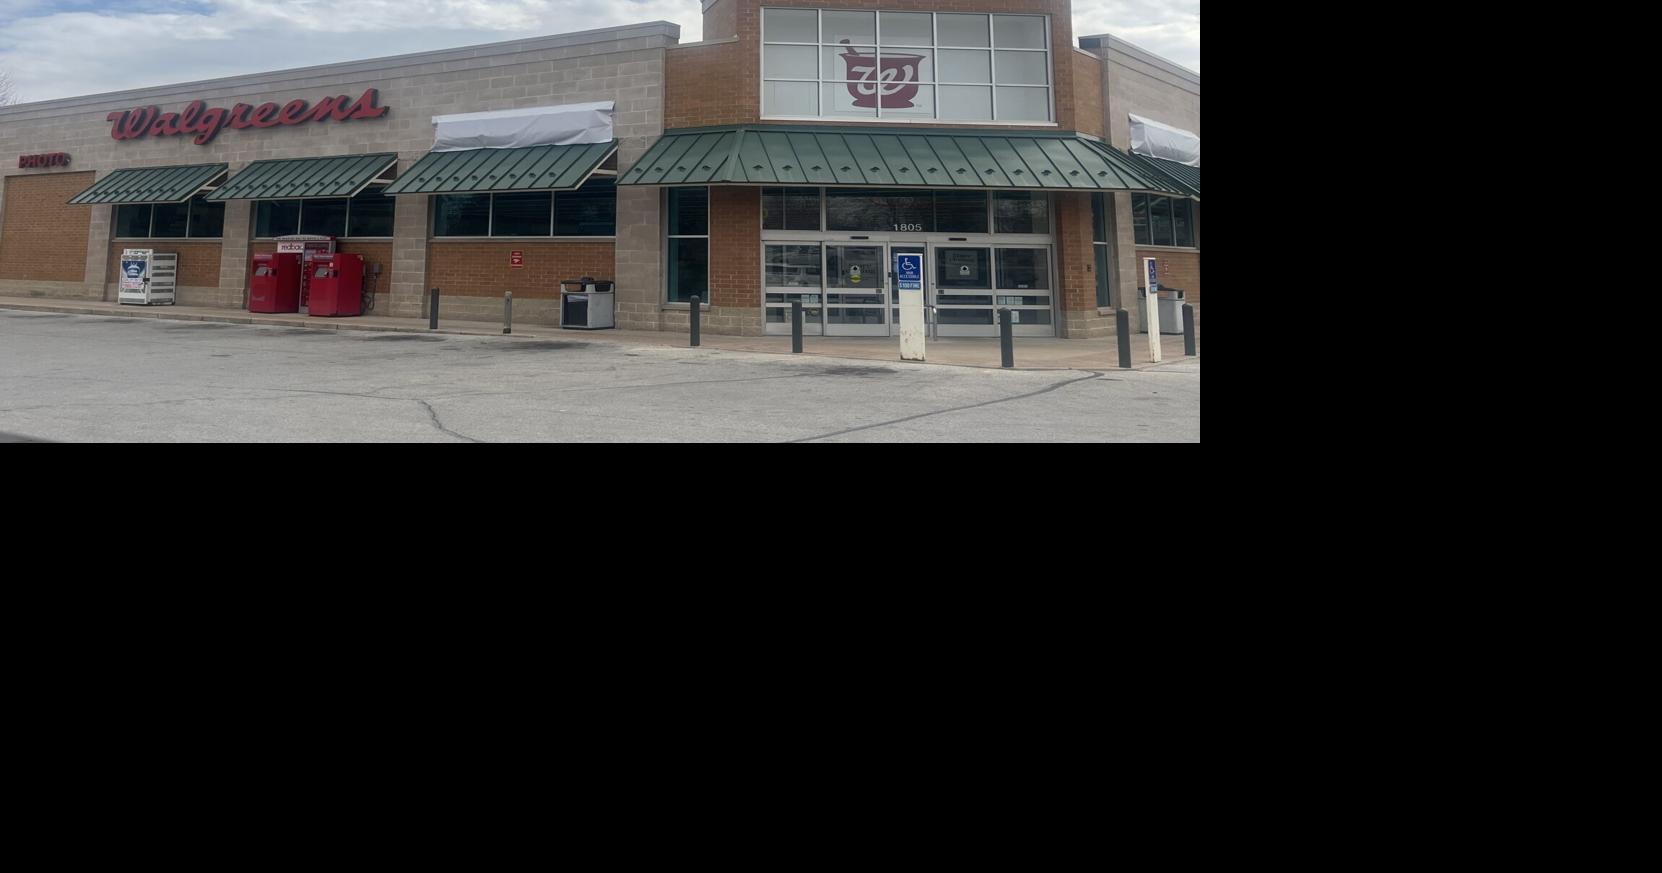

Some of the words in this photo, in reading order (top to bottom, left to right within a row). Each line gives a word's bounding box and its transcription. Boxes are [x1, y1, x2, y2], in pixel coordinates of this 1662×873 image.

[106, 87, 389, 145] Walgreens
[18, 151, 72, 168] PHOTO
[893, 223, 922, 232] 1805
